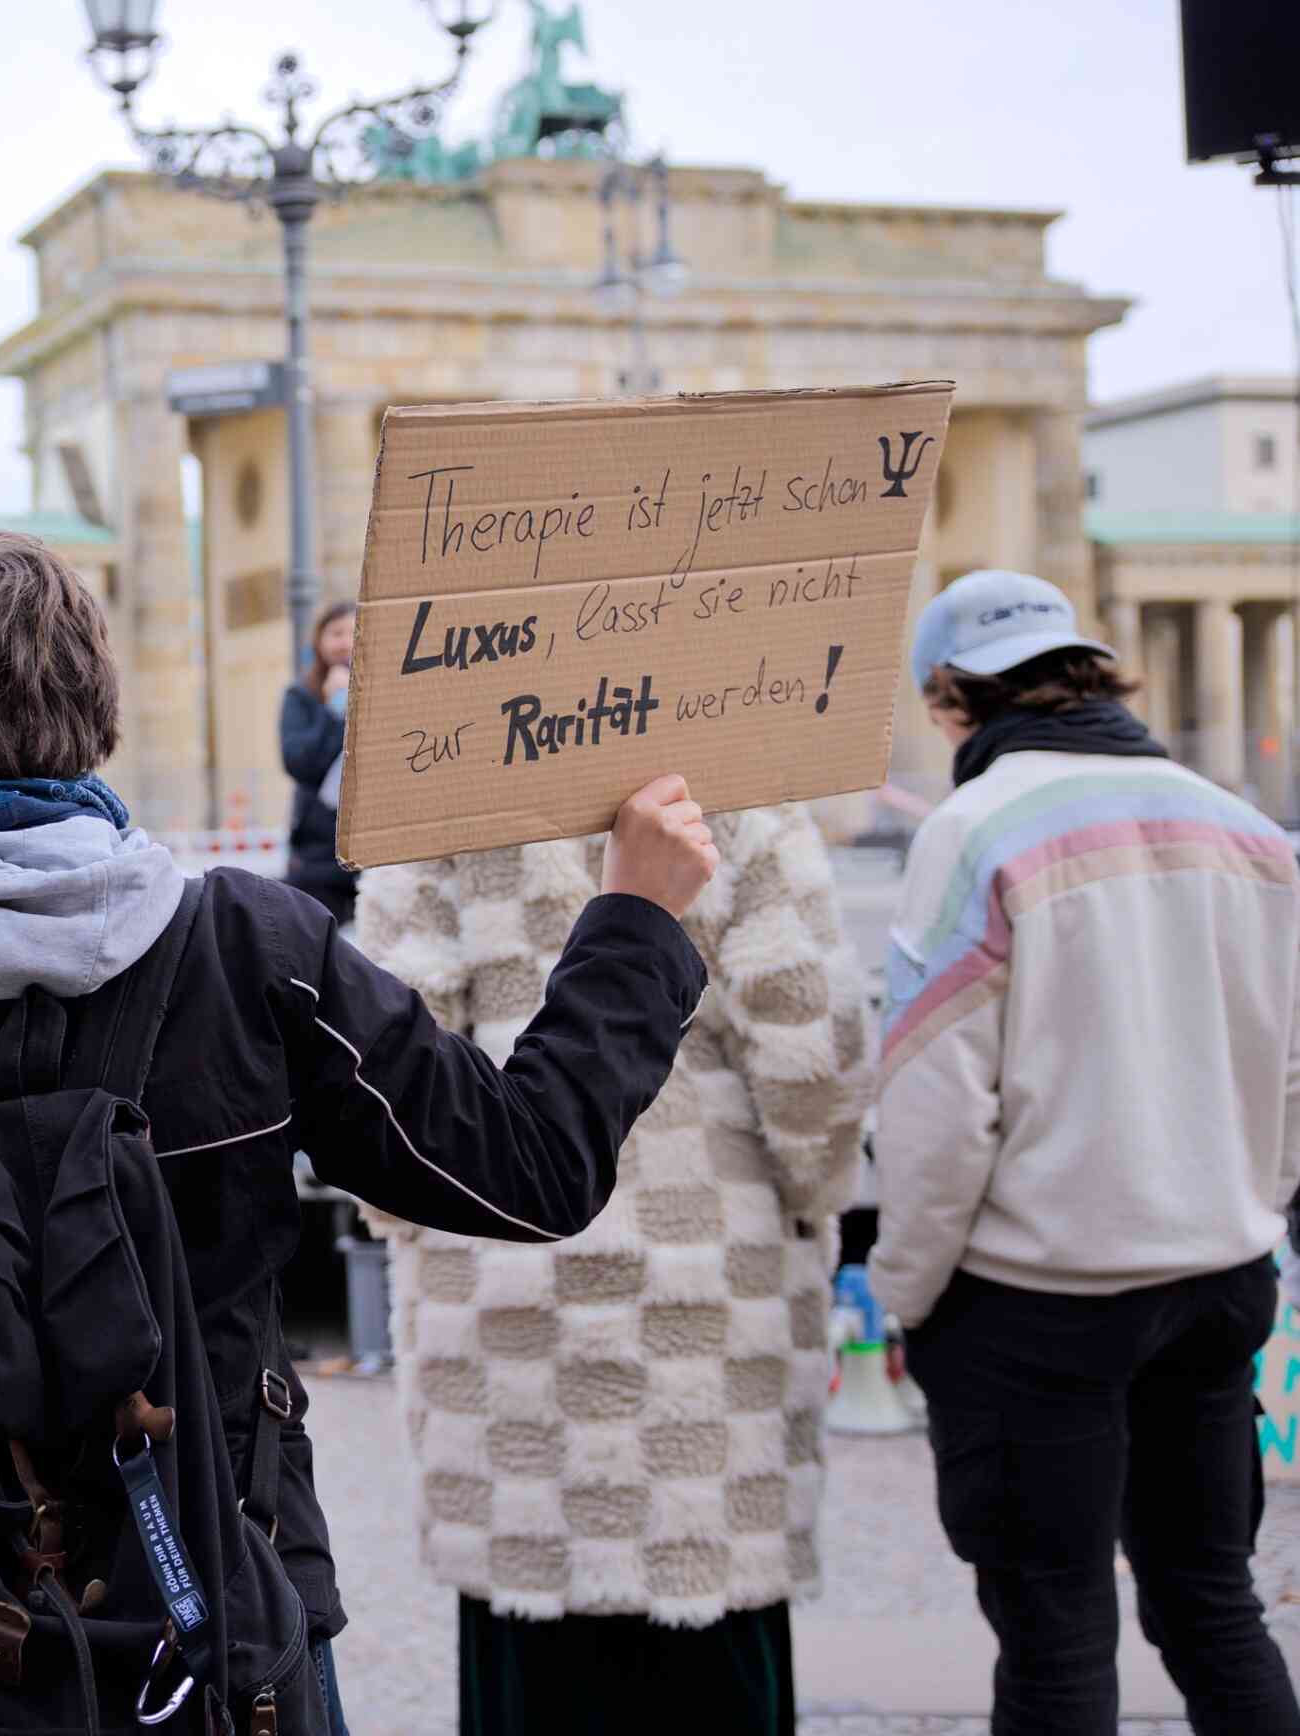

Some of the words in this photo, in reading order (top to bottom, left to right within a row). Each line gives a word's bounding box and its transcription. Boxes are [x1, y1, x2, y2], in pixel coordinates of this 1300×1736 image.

[407, 465, 596, 579] Therapie
[627, 467, 672, 531] ist
[670, 465, 769, 589] jetzt
[782, 457, 868, 513] schon
[400, 600, 557, 676] Luxus,
[575, 582, 673, 643] lasst
[692, 579, 745, 621] sie
[767, 551, 862, 609] nicht
[401, 721, 476, 773] zur
[501, 675, 661, 766] Rarität
[148, 1493, 171, 1537] THEMEN
[153, 1543, 168, 1563] DIR
[163, 1535, 184, 1567] DEINE
[161, 1562, 180, 1593] GÖNN
[177, 1567, 193, 1589] FÜR
